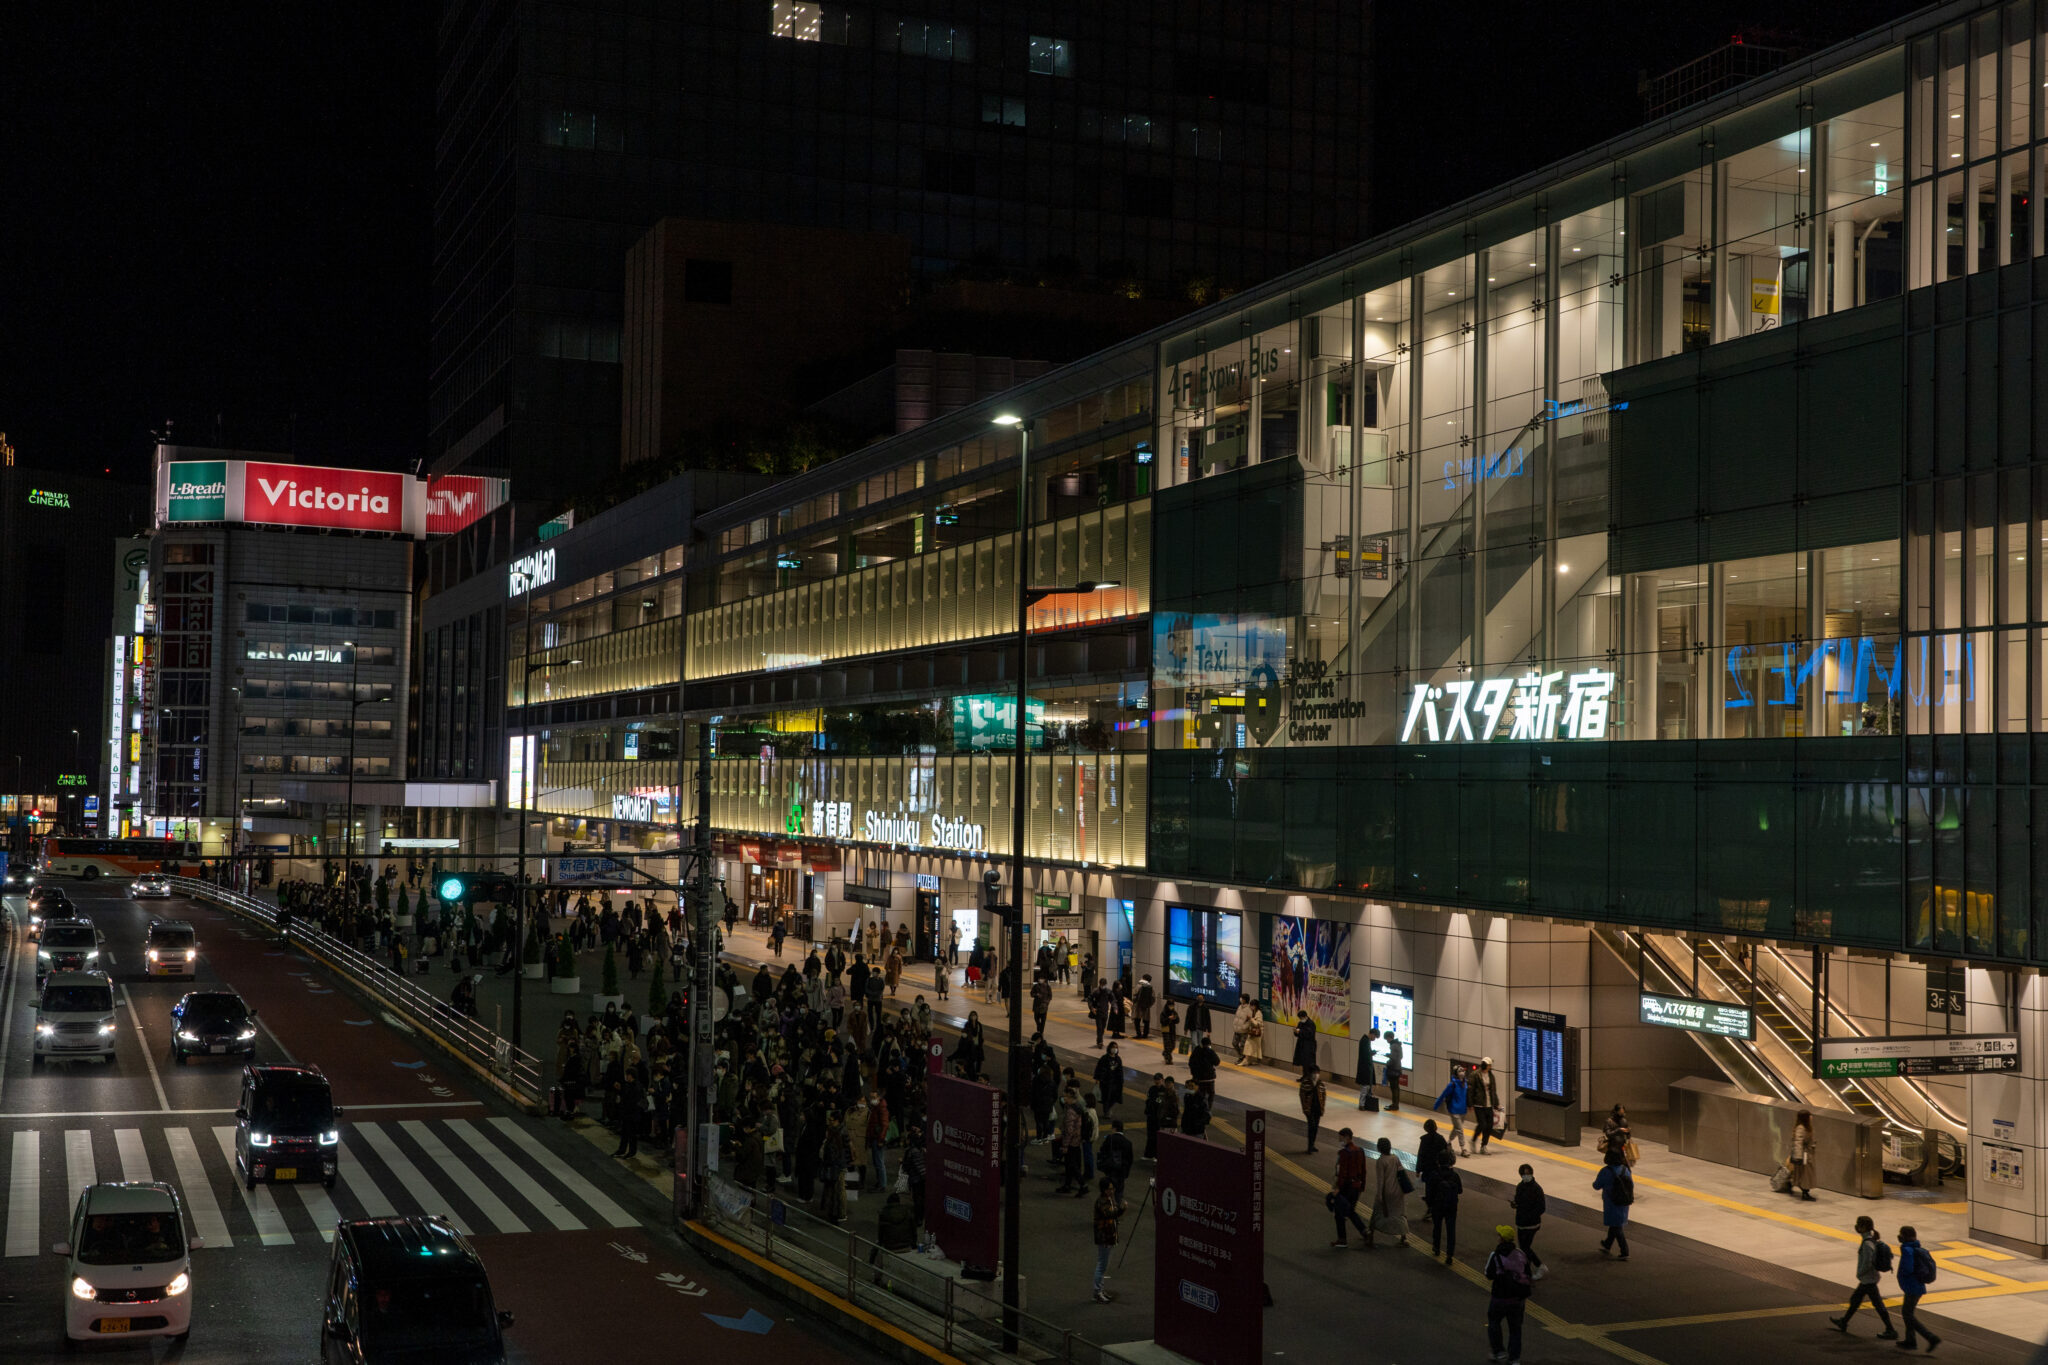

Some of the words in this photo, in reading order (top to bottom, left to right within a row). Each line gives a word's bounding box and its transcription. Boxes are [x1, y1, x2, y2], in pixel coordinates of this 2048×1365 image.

[1250, 347, 1278, 379] Bus
[169, 482, 225, 495] L-Breath
[257, 478, 389, 514] Victoria
[29, 495, 70, 509] CINEMA
[1194, 642, 1228, 673] Taxi
[1289, 658, 1327, 679] Tokyo
[1289, 678, 1334, 700] Tourist
[1289, 699, 1366, 721] Information
[1401, 667, 1615, 742] バスタ新宿
[1289, 722, 1332, 742] Center
[613, 795, 651, 822] NEWoMan
[786, 804, 802, 834] JR
[812, 800, 852, 838] 新宿駅
[865, 809, 921, 850] Shinjuku
[931, 814, 983, 850] Station
[1663, 1001, 1705, 1019] バスタ新宿
[1930, 992, 1945, 1009] 3F
[1836, 1062, 1848, 1072] JR
